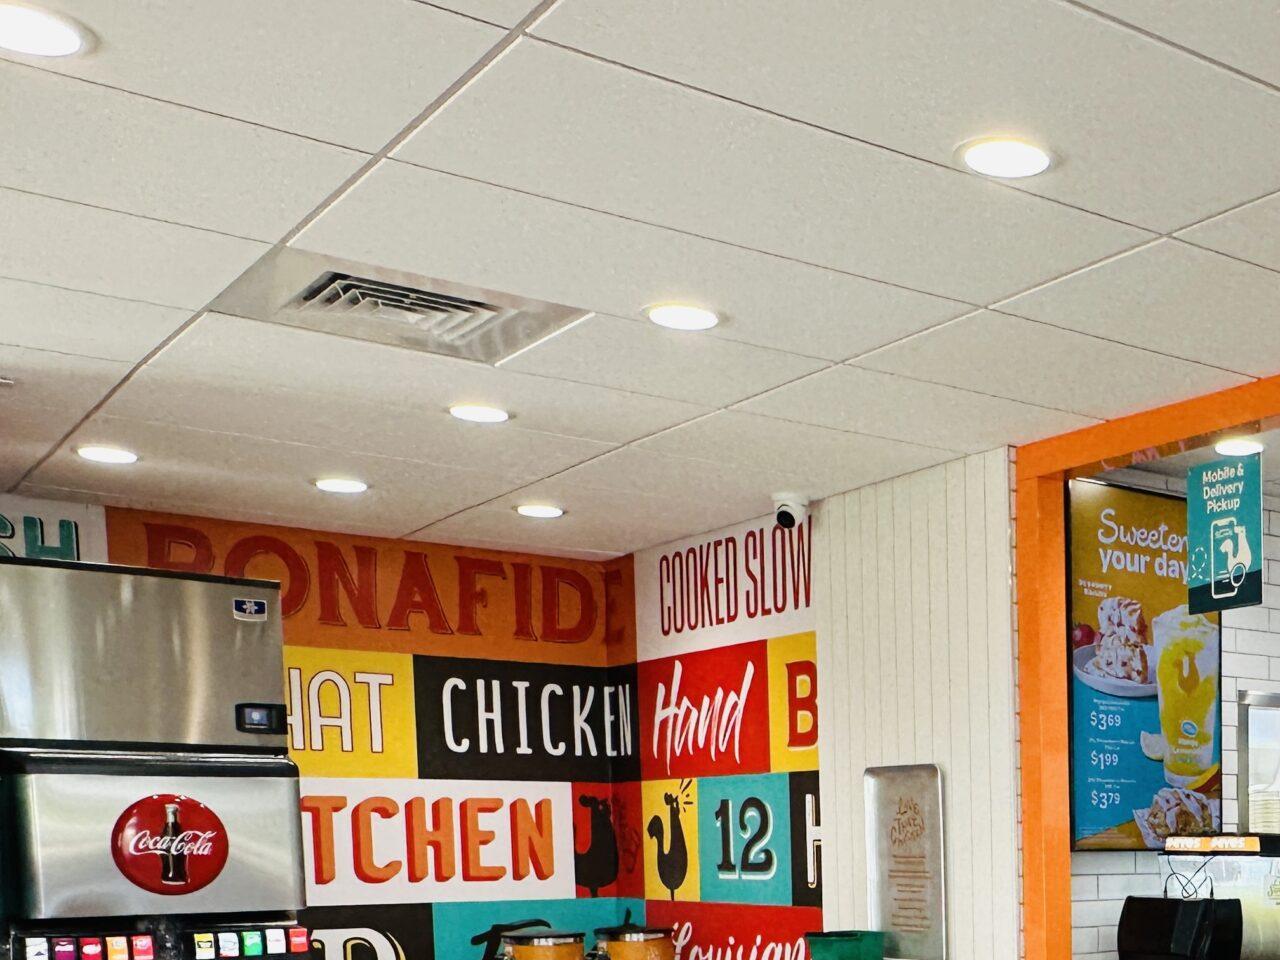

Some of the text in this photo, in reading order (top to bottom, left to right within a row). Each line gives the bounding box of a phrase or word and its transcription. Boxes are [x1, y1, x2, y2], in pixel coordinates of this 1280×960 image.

[1203, 463, 1244, 484] Mobile &
[1203, 480, 1244, 499] Delivery
[1207, 498, 1240, 514] Pickup
[659, 514, 813, 636] COOKED SLOW
[1099, 548, 1188, 585] your day
[442, 676, 632, 758] CHICKEN
[653, 660, 754, 776] Hand
[128, 829, 217, 856] Coca-Cola
[300, 795, 555, 885] TCHEN
[716, 796, 777, 880] 12
